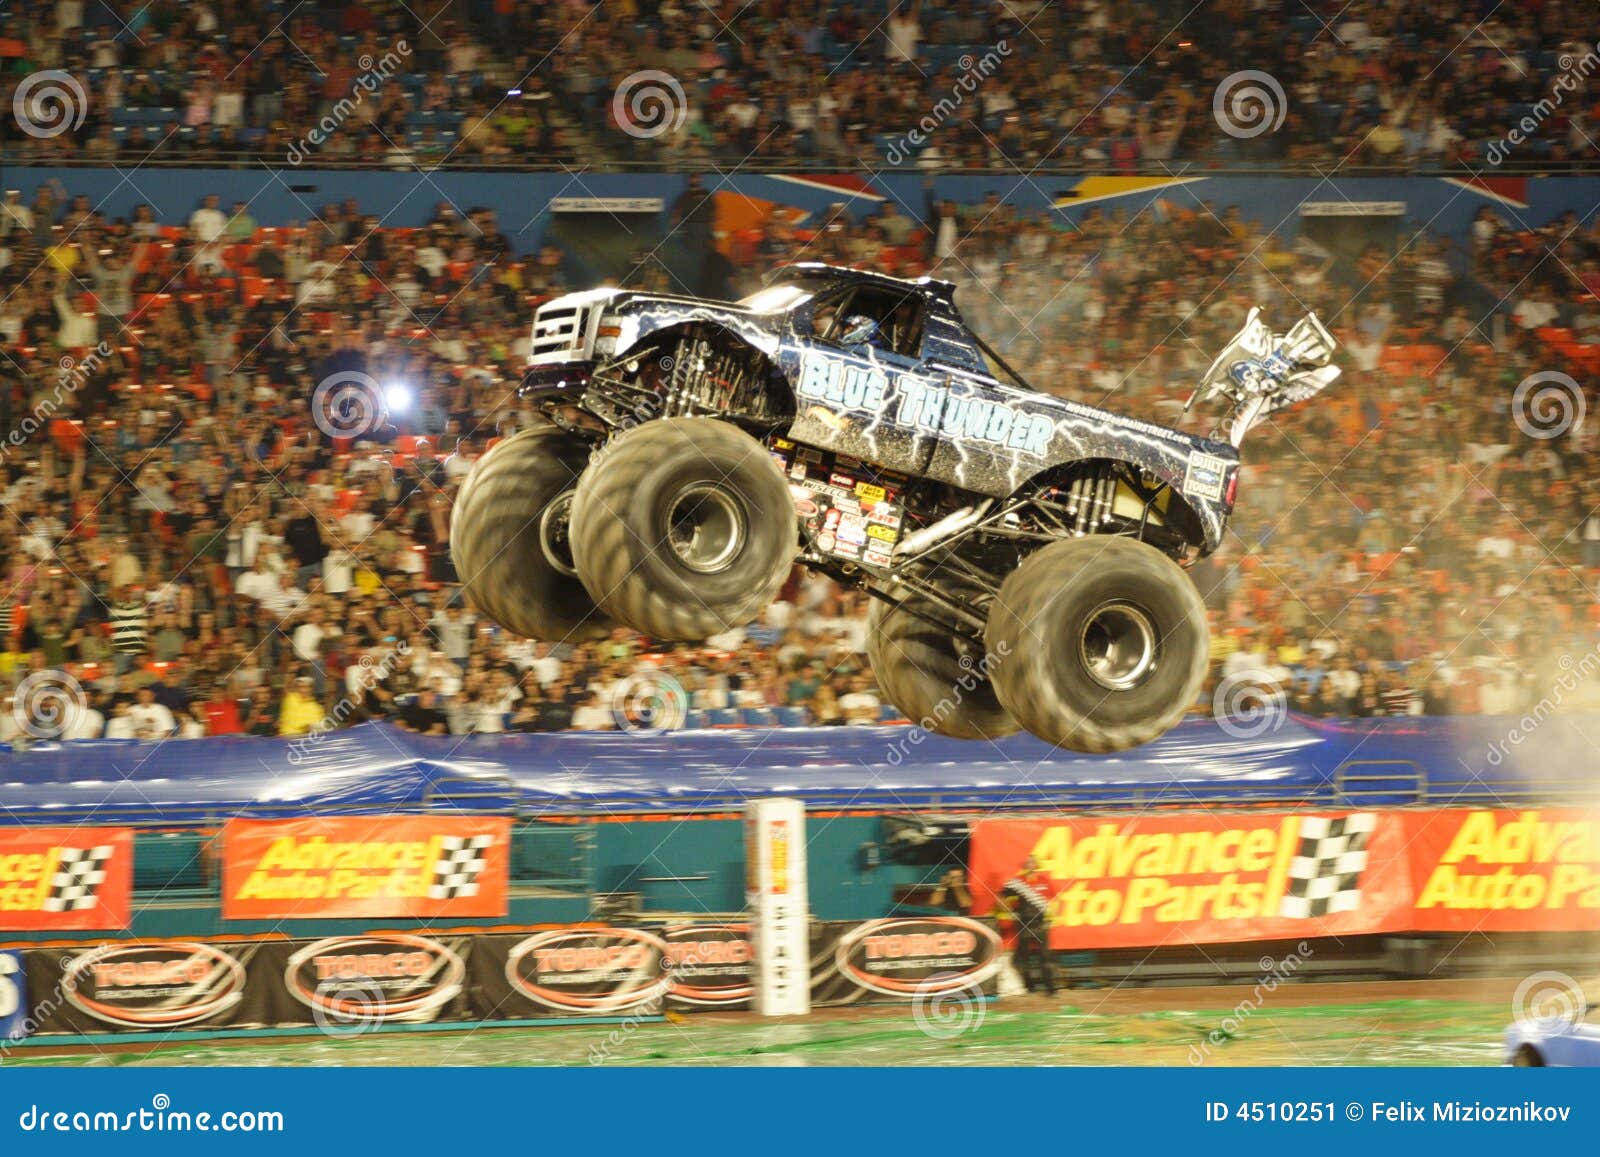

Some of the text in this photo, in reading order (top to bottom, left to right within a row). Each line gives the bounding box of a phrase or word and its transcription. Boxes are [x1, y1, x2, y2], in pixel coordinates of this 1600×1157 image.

[798, 352, 1054, 459] BLUE THUNDER
[1191, 454, 1223, 473] BUILT
[256, 835, 427, 869] Advance
[1033, 824, 1277, 880] Advance
[1440, 811, 1600, 863] Adva
[235, 869, 424, 899] Auto Parts
[1119, 874, 1265, 924] Parts
[1415, 865, 1546, 909] Auto
[533, 945, 651, 973] TORCO
[864, 931, 977, 959] TORCO
[313, 952, 434, 980] TORCO
